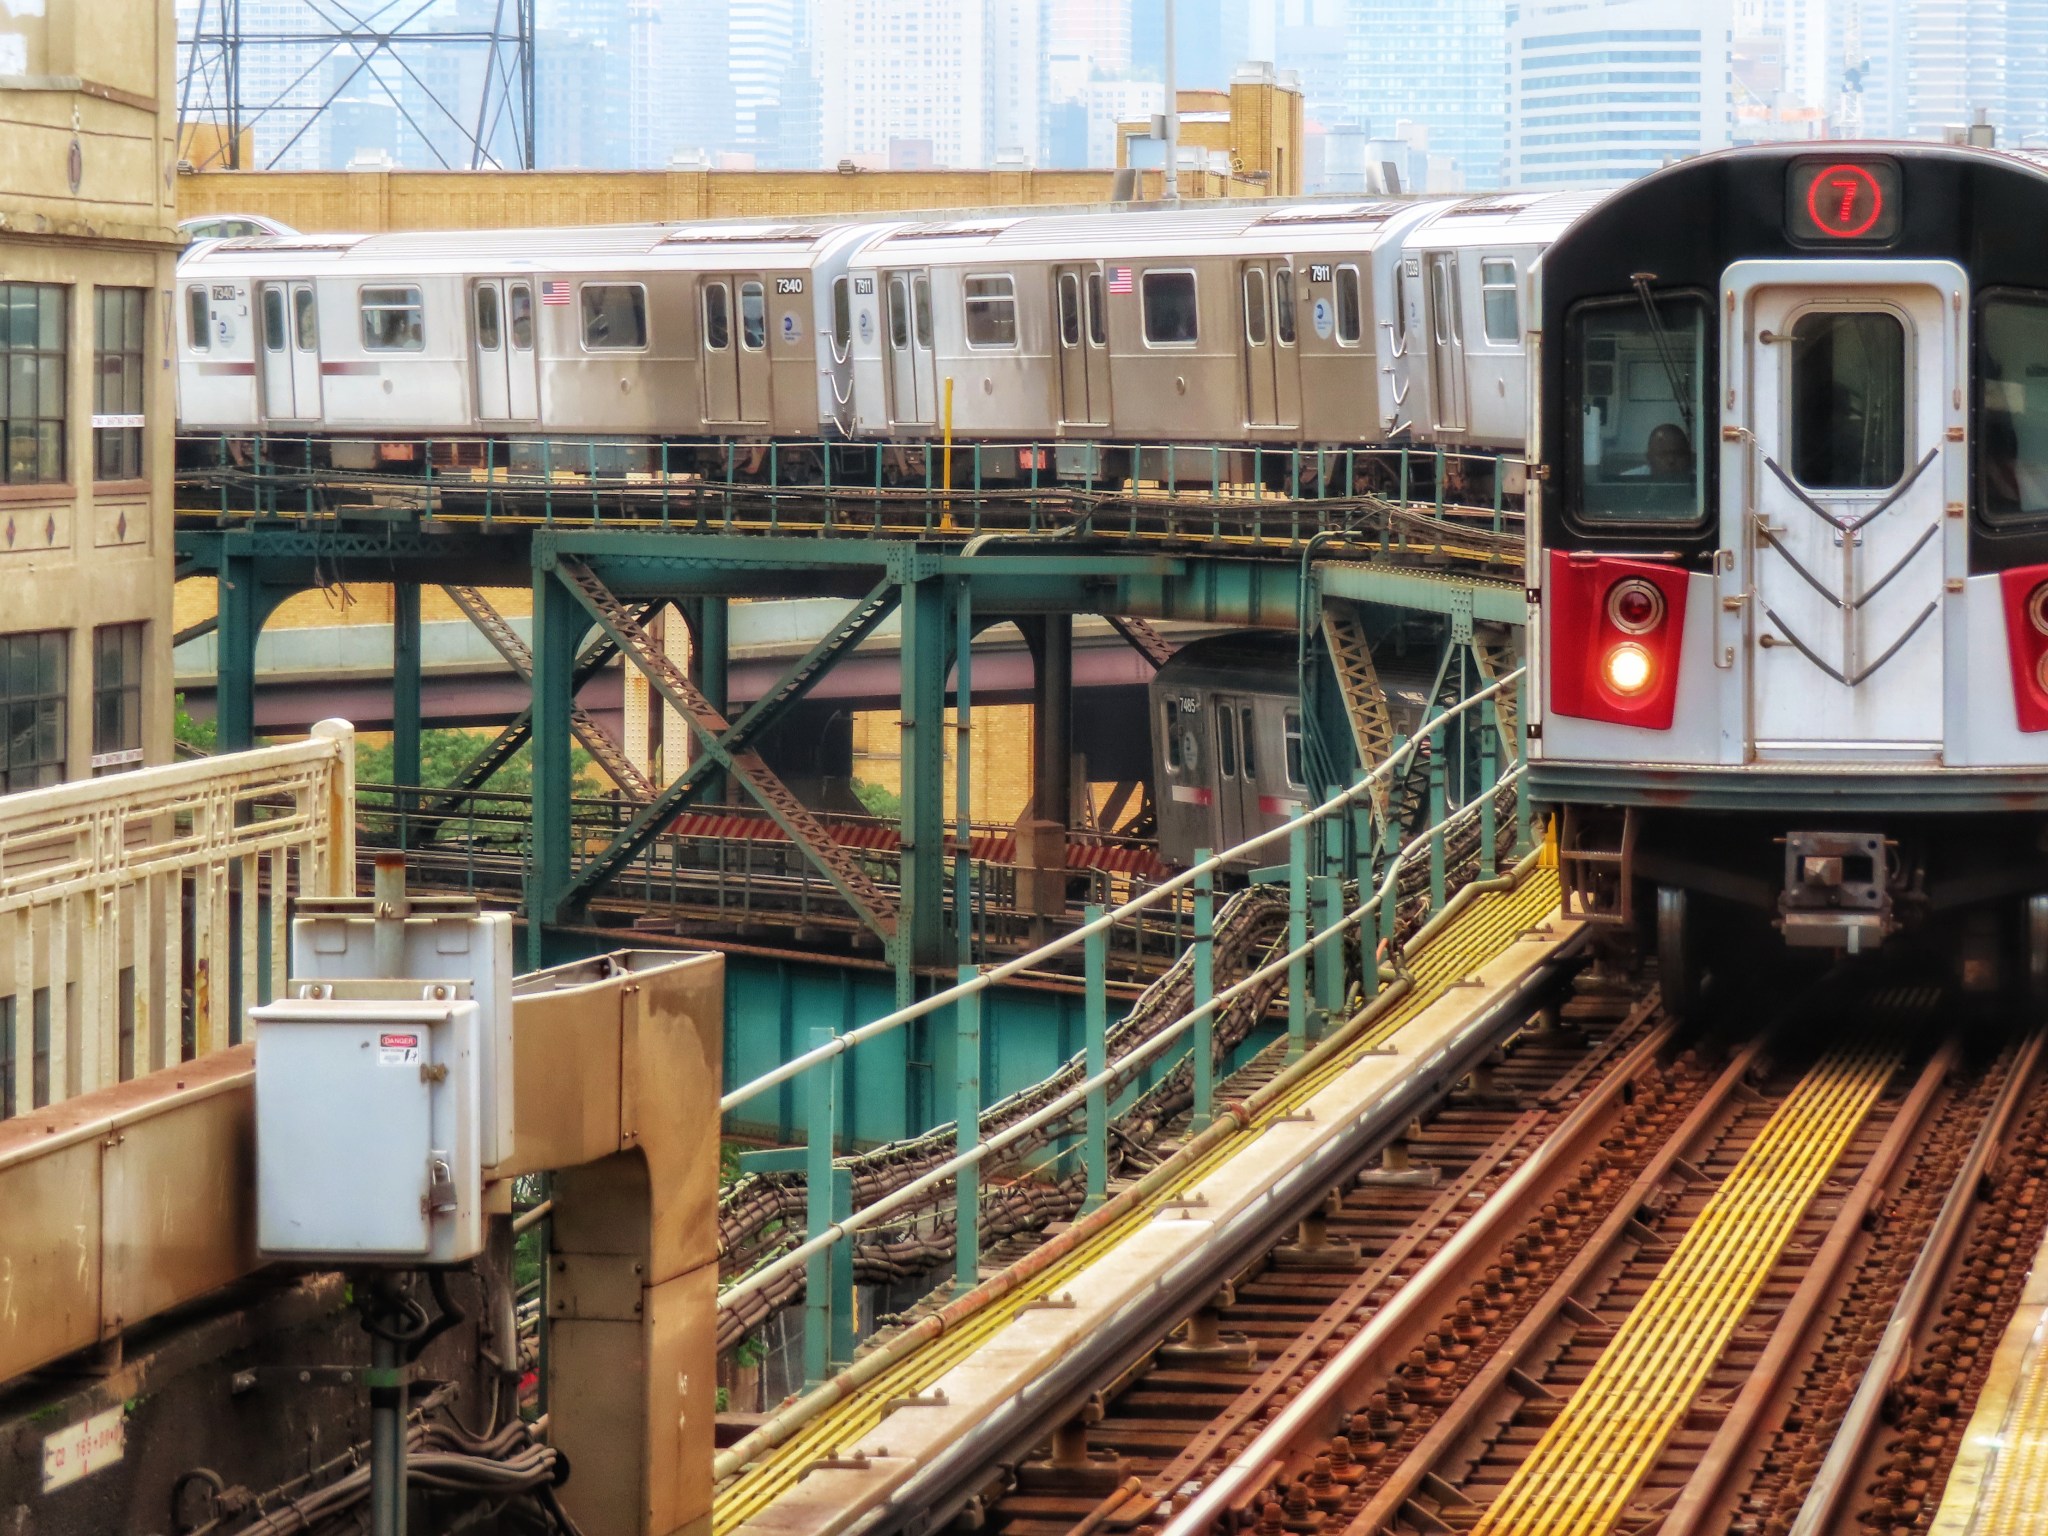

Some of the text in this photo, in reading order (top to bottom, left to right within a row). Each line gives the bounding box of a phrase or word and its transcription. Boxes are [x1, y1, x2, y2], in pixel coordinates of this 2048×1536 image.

[1831, 181, 1857, 222] 7
[1311, 265, 1331, 281] 7911
[212, 285, 235, 299] 7340
[776, 278, 802, 293] 7340
[856, 279, 872, 293] 7911
[384, 1037, 414, 1045] DANGER
